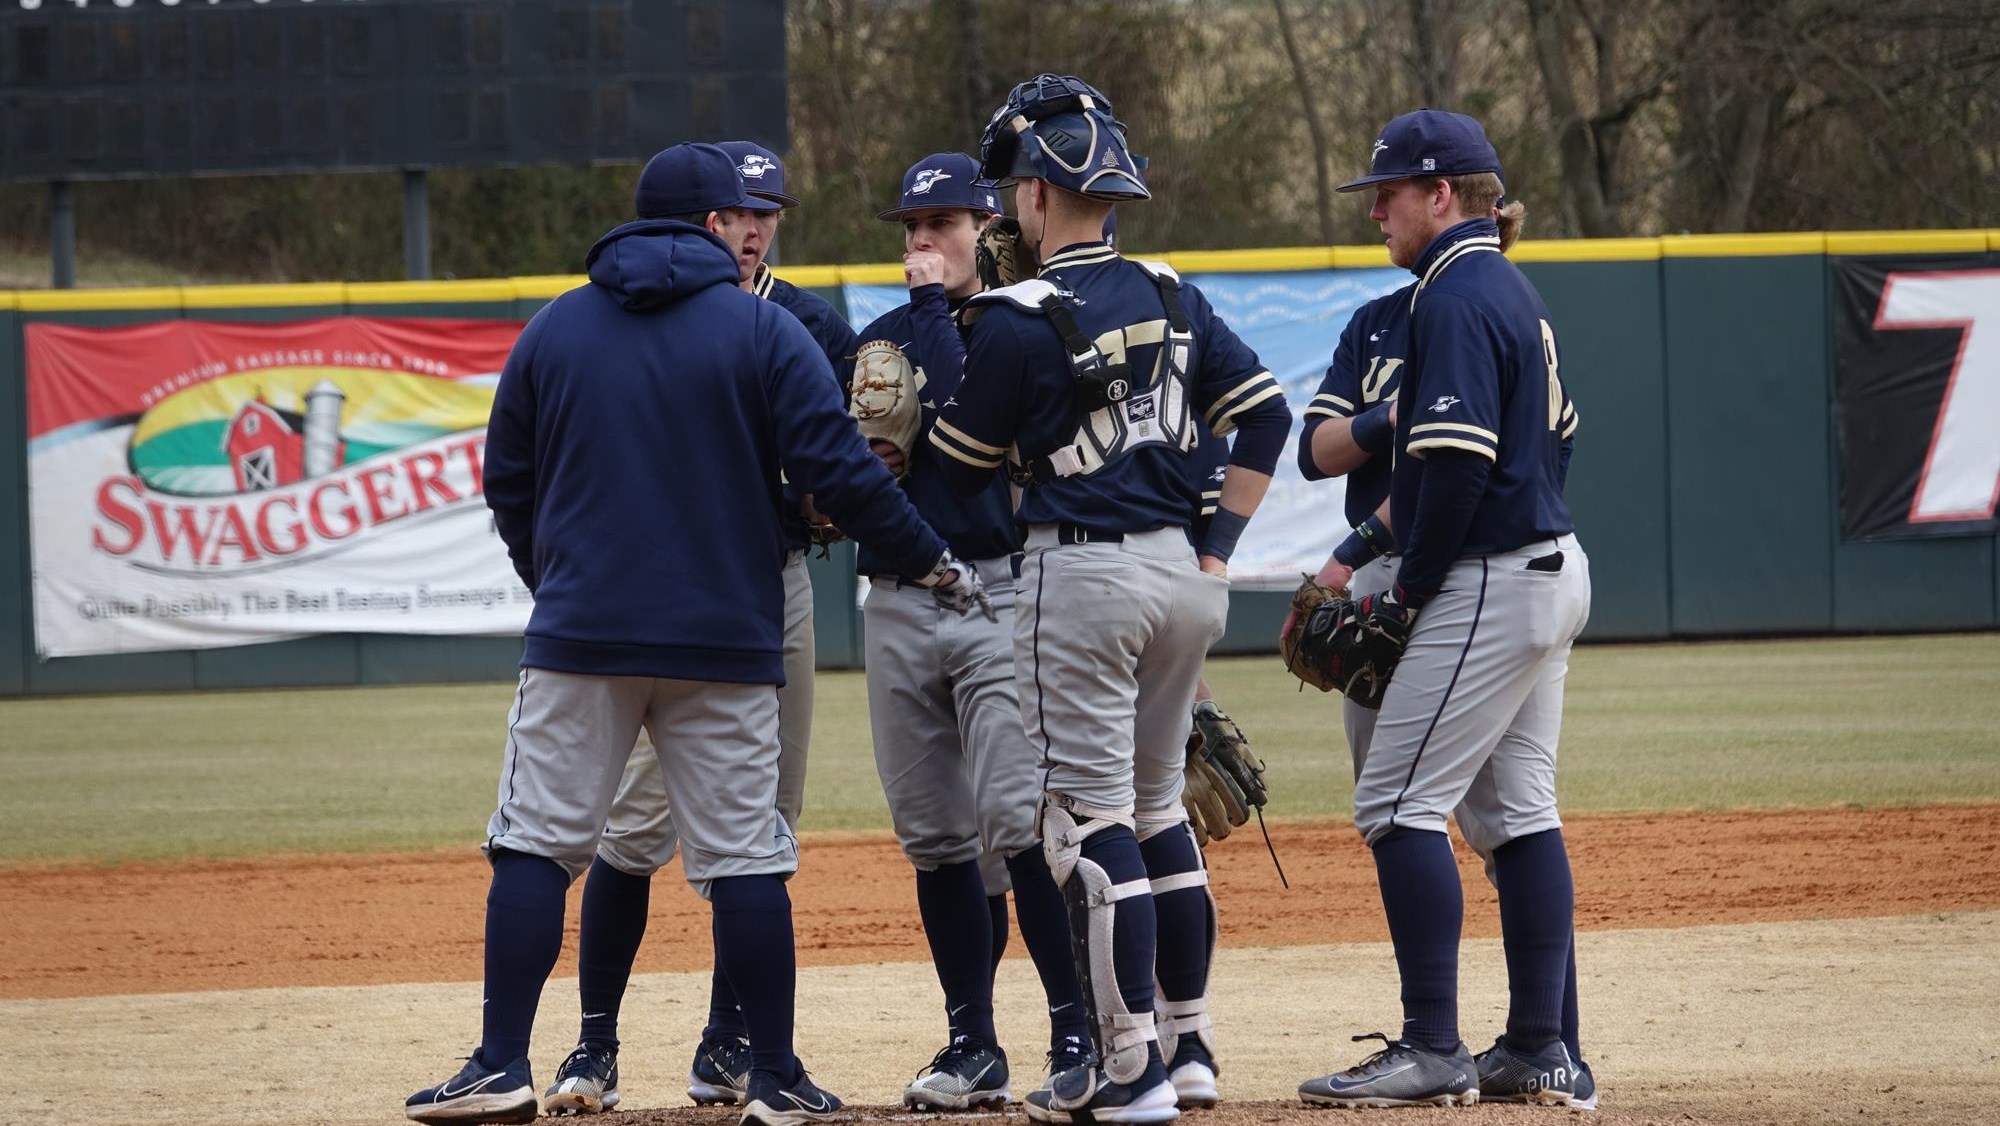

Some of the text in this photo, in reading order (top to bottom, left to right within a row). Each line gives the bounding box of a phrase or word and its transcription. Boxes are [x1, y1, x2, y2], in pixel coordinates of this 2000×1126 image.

[140, 361, 229, 406] PREMIUM
[235, 350, 324, 373] SAUSAGE
[332, 350, 393, 370] SINCE
[78, 596, 138, 621] Quite
[242, 591, 280, 615] The
[285, 589, 330, 614] Best
[335, 586, 412, 615] Tasting
[417, 584, 506, 610] Sausage
